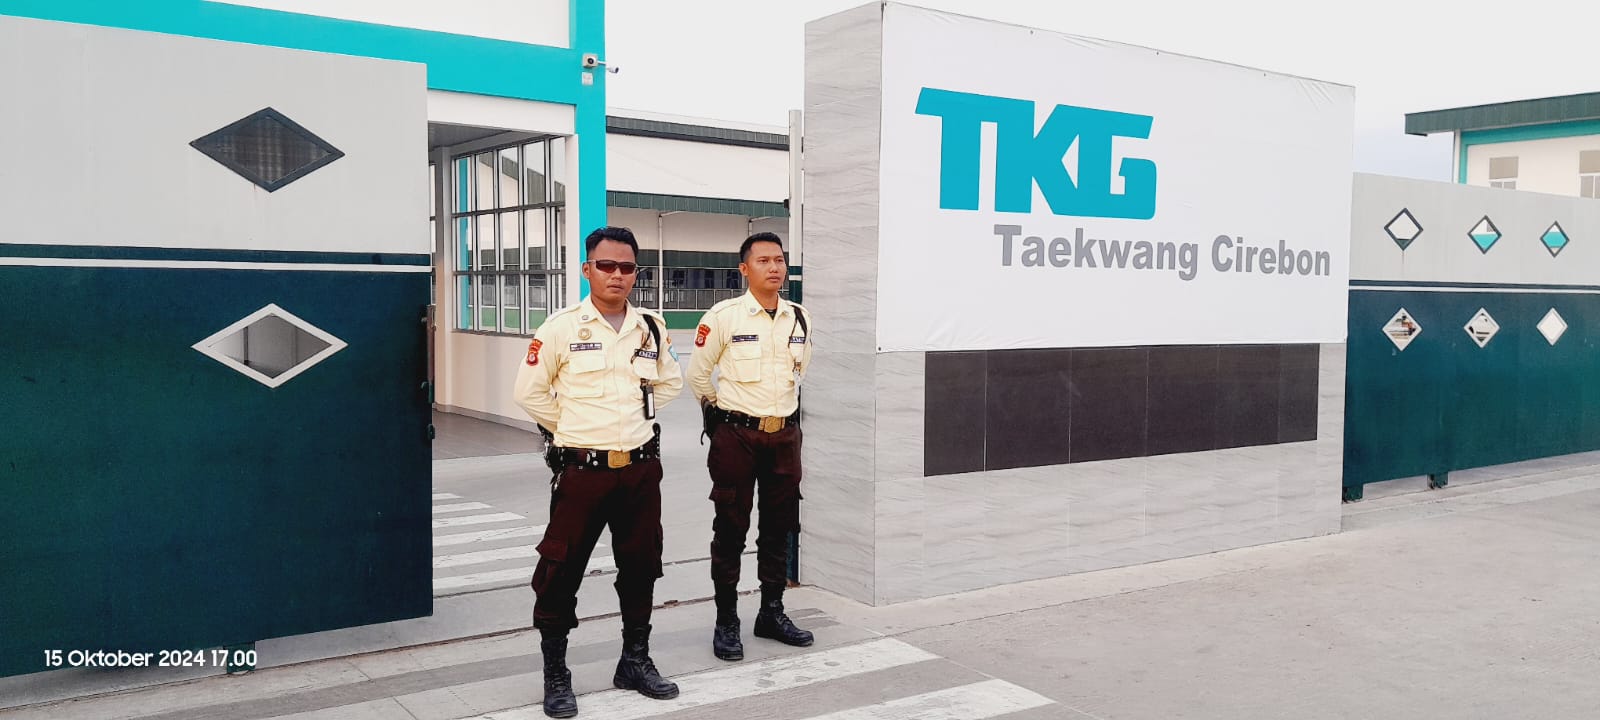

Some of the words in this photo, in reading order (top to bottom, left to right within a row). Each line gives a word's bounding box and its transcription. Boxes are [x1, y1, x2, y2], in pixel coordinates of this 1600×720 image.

[915, 87, 1157, 220] TKG
[993, 224, 1199, 281] Taekwang
[1211, 235, 1331, 277] Cirebon
